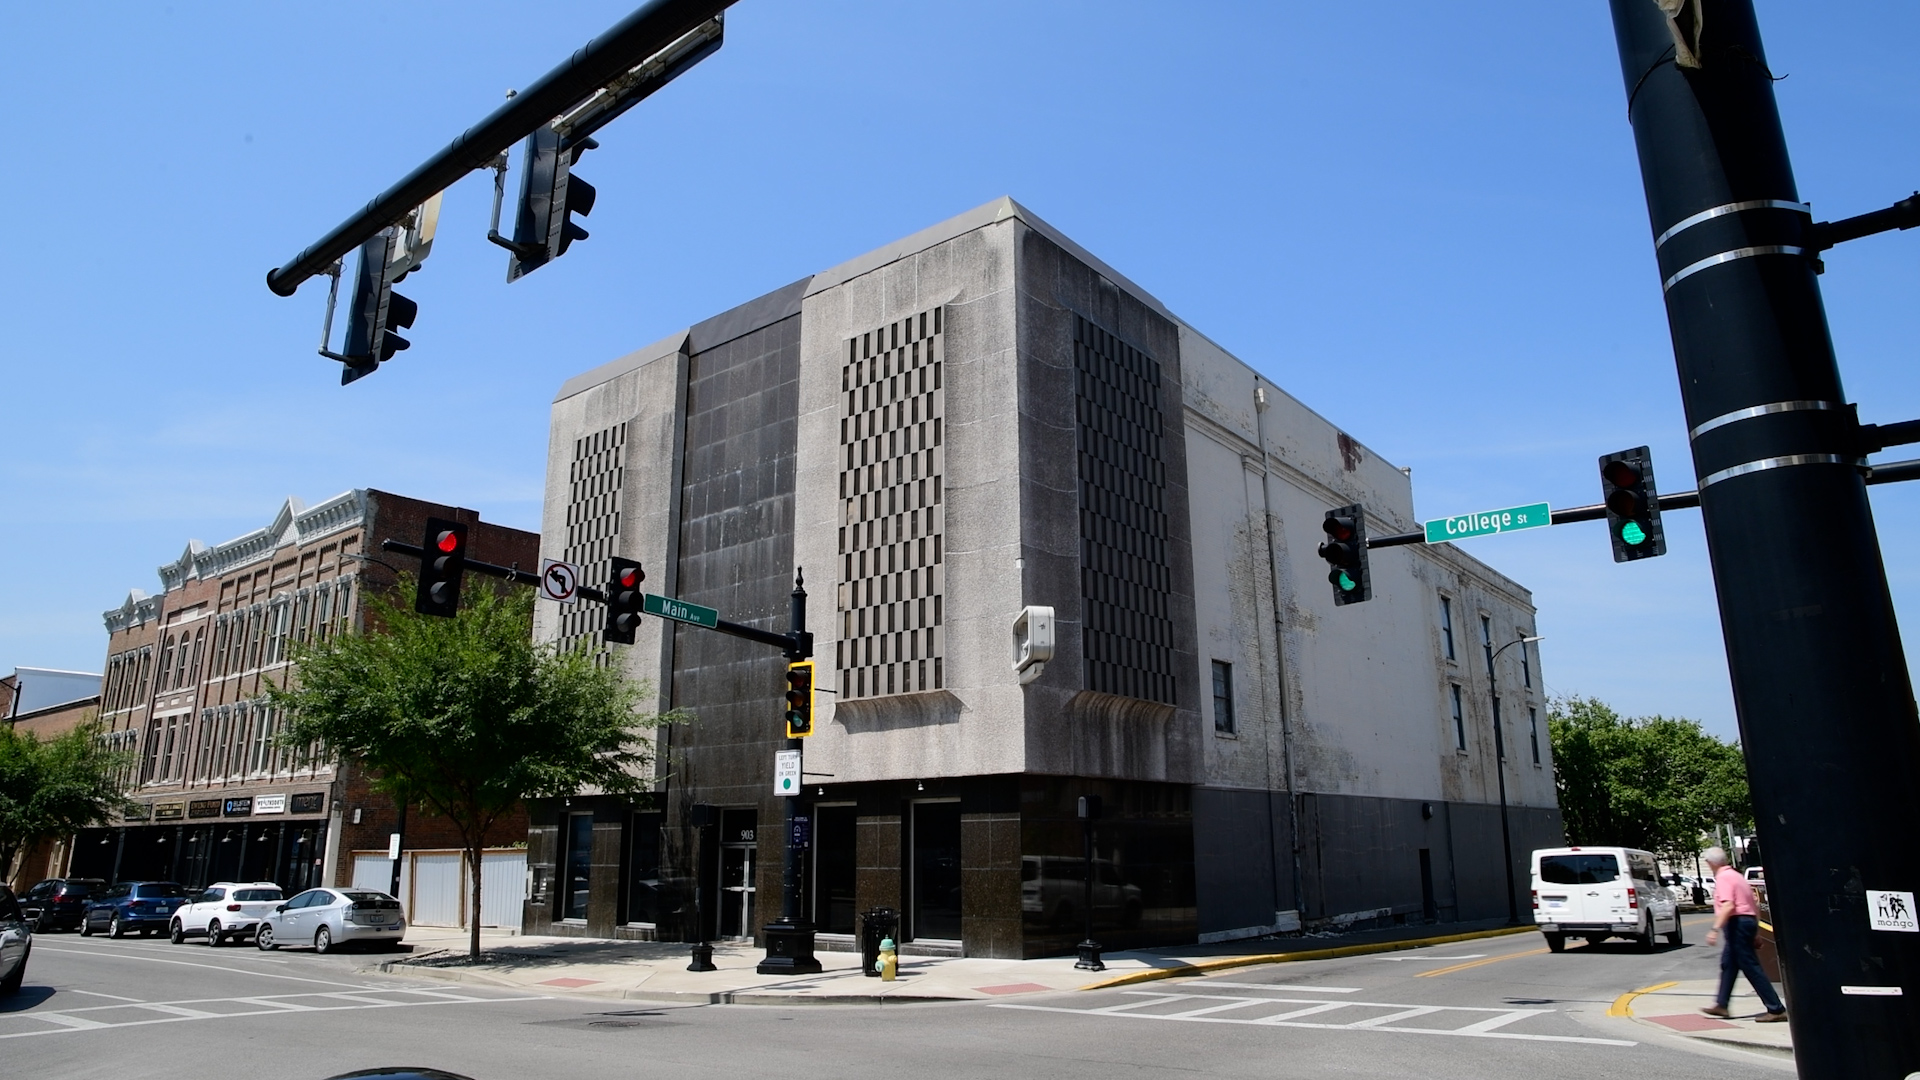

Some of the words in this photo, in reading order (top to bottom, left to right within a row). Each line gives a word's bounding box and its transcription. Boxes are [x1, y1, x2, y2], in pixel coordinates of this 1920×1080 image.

[1445, 512, 1512, 535] College
[1517, 513, 1528, 525] St
[662, 600, 688, 619] Main
[690, 612, 701, 622] Ave
[781, 761, 795, 769] YIELD
[741, 829, 755, 840] 903
[1877, 919, 1914, 929] mongo
